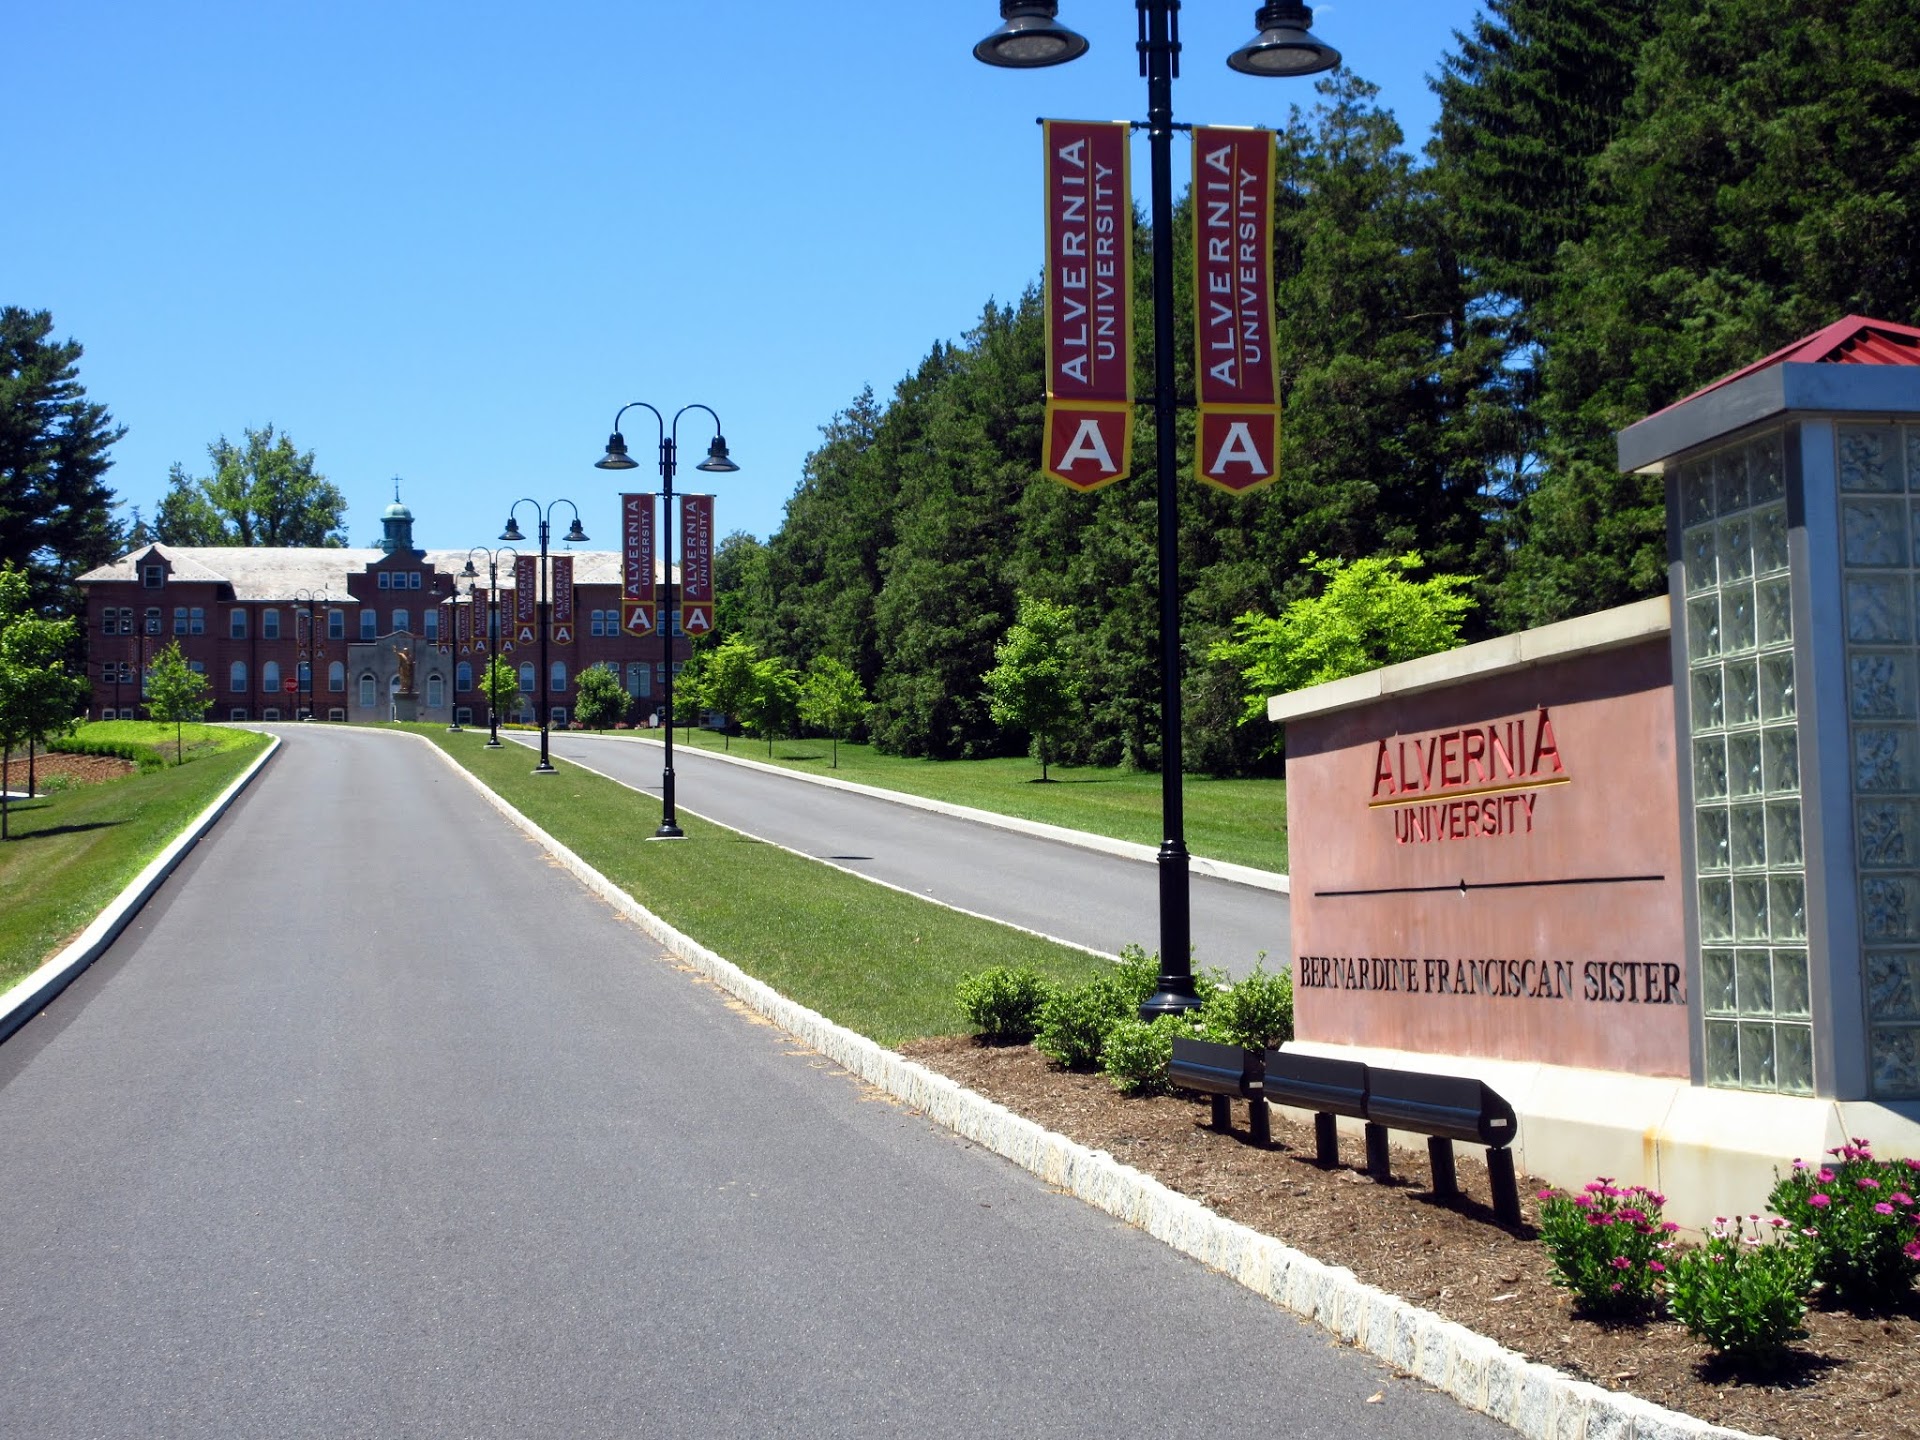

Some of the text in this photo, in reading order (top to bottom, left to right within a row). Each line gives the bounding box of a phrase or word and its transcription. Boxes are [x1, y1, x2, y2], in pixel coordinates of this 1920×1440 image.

[1059, 138, 1088, 385] ALVERNIA
[1095, 162, 1116, 361] UNIVERSITY
[1206, 144, 1237, 387] ALVERNIA
[1239, 168, 1262, 364] UNIVERSITY
[1057, 419, 1118, 473] A
[1209, 422, 1268, 475] A
[627, 500, 639, 595] ALVERNIA
[641, 509, 650, 586] UNIVERSITY
[686, 501, 698, 595] ALVERNIA
[700, 510, 708, 587] UNIVERSITY
[519, 627, 534, 640] A
[556, 627, 570, 640] A
[627, 607, 651, 629] A
[686, 608, 710, 629] A
[440, 645, 449, 654] A
[461, 645, 470, 654] A
[475, 641, 485, 650] A
[502, 641, 513, 651] A
[1371, 708, 1564, 798] ALVERNIA
[1394, 793, 1538, 845] UNIVERSITY
[1300, 956, 1687, 1005] BERNARDINE FRANCISCAN SISTER
